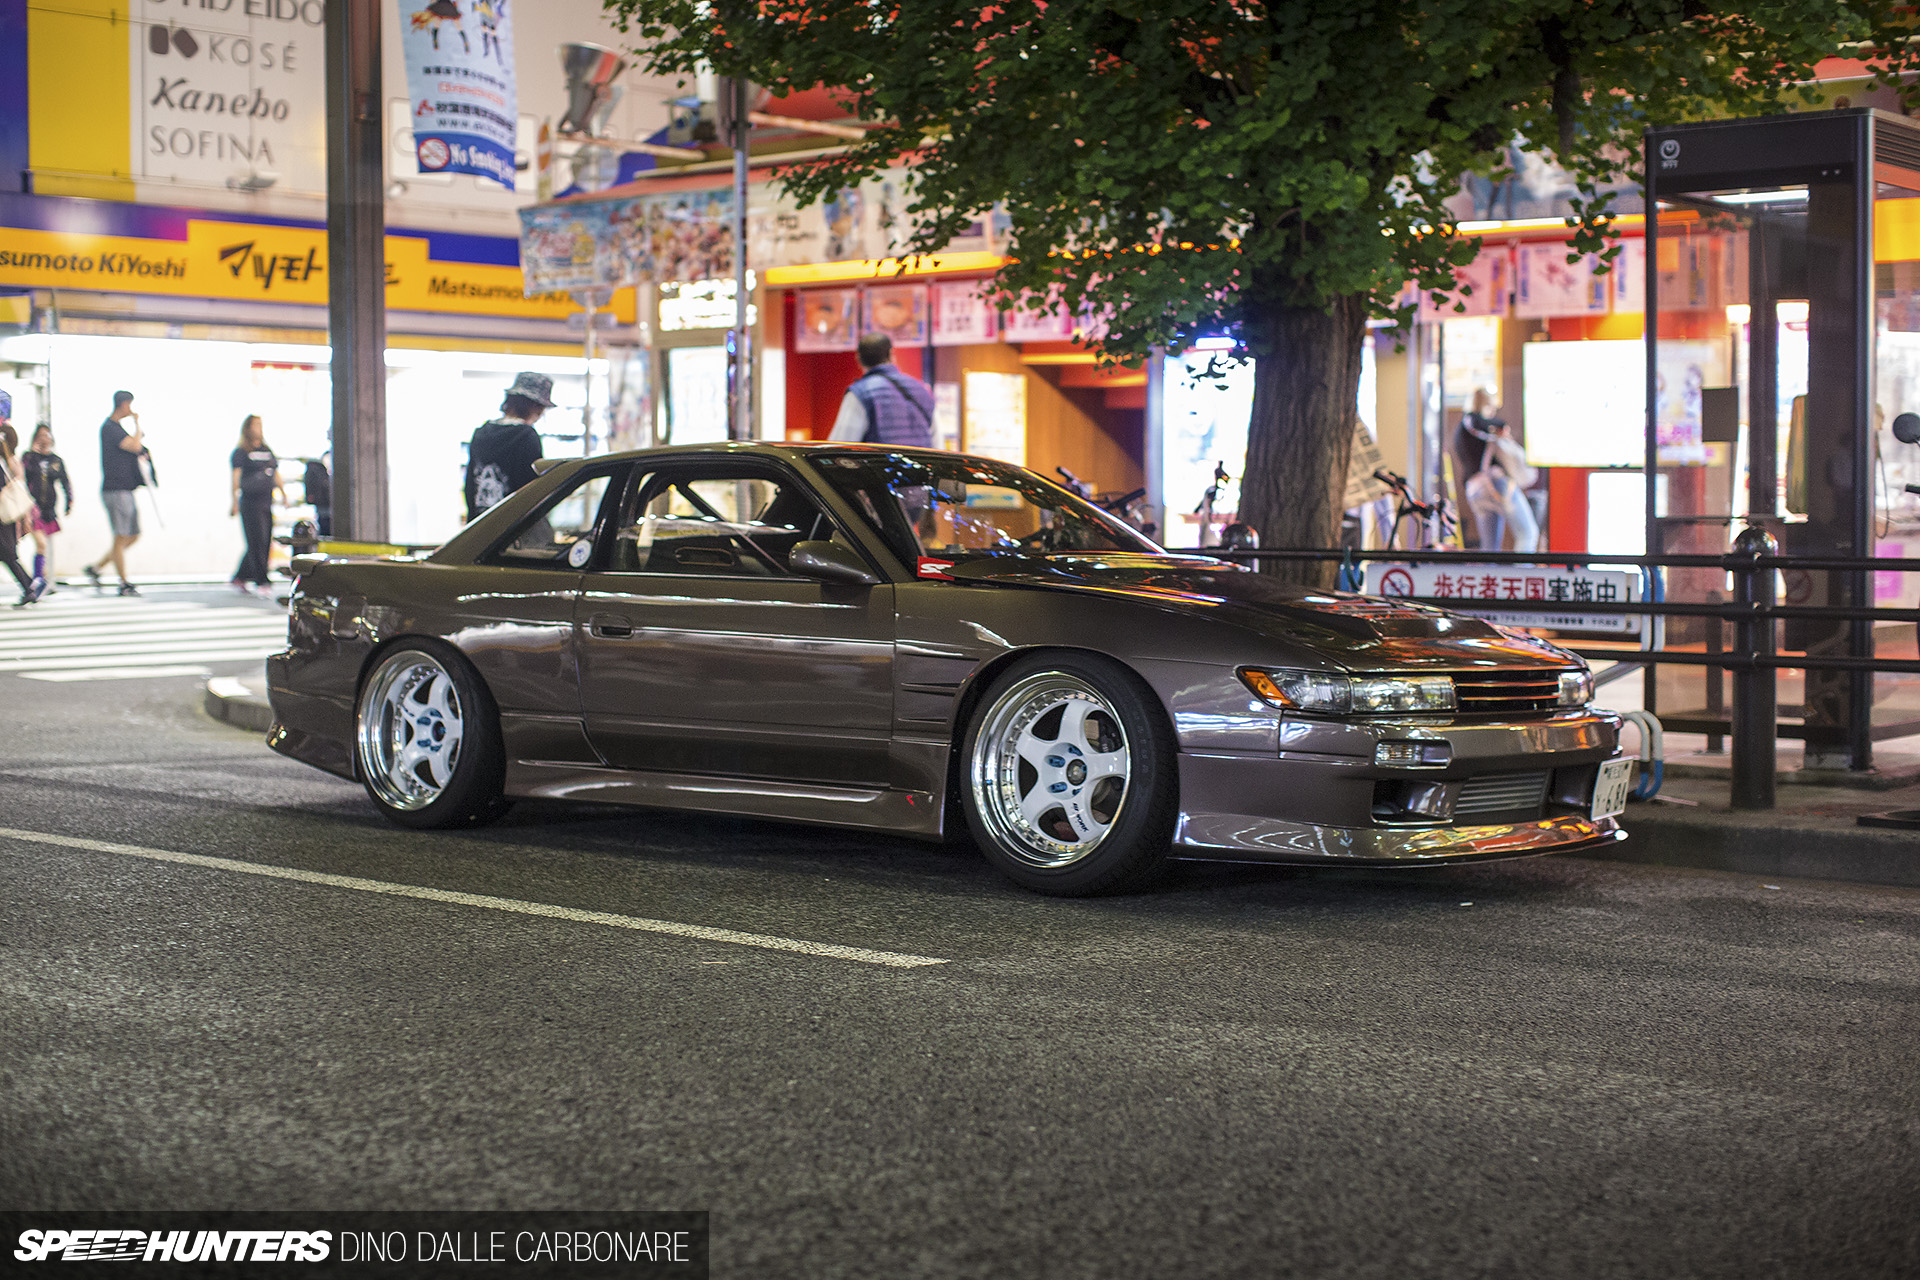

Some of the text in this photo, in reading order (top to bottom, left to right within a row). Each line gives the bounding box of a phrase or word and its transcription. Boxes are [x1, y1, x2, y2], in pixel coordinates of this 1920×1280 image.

[208, 34, 298, 73] KOSÉ
[152, 76, 290, 122] Kanebo
[150, 125, 275, 167] SOFINA
[98, 253, 187, 279] KiYoshi
[1433, 573, 1617, 603] 歩行者天国実施中
